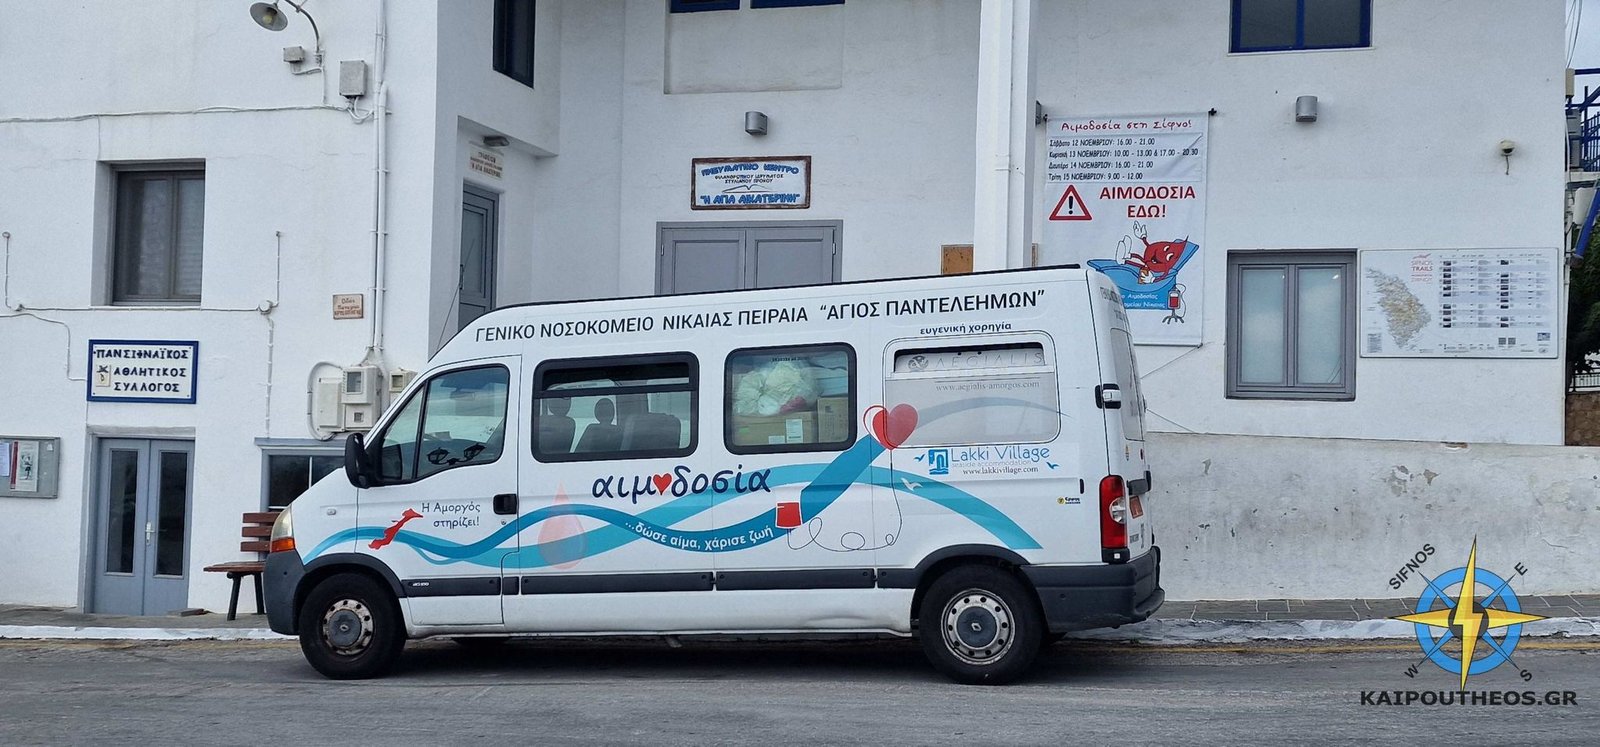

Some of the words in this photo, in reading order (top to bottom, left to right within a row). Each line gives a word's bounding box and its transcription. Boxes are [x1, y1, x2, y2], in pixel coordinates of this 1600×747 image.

[1061, 118, 1121, 133] Αιμοδοσία
[1126, 121, 1148, 130] στη
[1153, 118, 1192, 131] Σίφνο!
[1080, 138, 1115, 146] ΝΟΕΜΒΡΙΟΥ:
[1117, 138, 1132, 146] 16.00
[1140, 138, 1155, 146] 21.00
[1069, 150, 1076, 158] 13
[1077, 150, 1112, 158] ΝΟΕΜΒΡΙΟΥ:
[1182, 148, 1198, 156] 20.30
[1078, 161, 1113, 169] ΝΟΕΜΒΡΙΟΥ:
[1127, 172, 1143, 180] 12.00
[713, 194, 736, 204] ΑΓΙΑ
[1100, 186, 1196, 200] ΑΙΜΟΔΟΣΙΑ
[1127, 205, 1166, 218] ΕΔΩ!
[476, 324, 535, 342] ΓΕΝΙΚΟ
[540, 316, 654, 338] ΝΟΣΟΚΟΜΕΙΟ
[663, 311, 733, 330] ΝΙΚΑΙΑΣ
[738, 307, 808, 325] ΠΕΙΡΑΙΑ
[920, 324, 966, 335] ευγενική
[968, 322, 1012, 333] χορηγία
[114, 367, 186, 377] ΑΘΛΗΤΙΚΟΣ
[114, 382, 180, 392] ΣΥΛΛΟΓΟΣ
[951, 446, 989, 462] Lakki
[994, 445, 1050, 462] Village
[962, 466, 1039, 475] www.lakkivillage.com
[592, 464, 772, 504] αιμδοσία
[422, 502, 430, 512] Η
[433, 501, 480, 514] Αμοργός
[433, 516, 479, 529] στηρίζει!
[705, 536, 746, 551] χάρισε
[749, 525, 774, 544] ζωή
